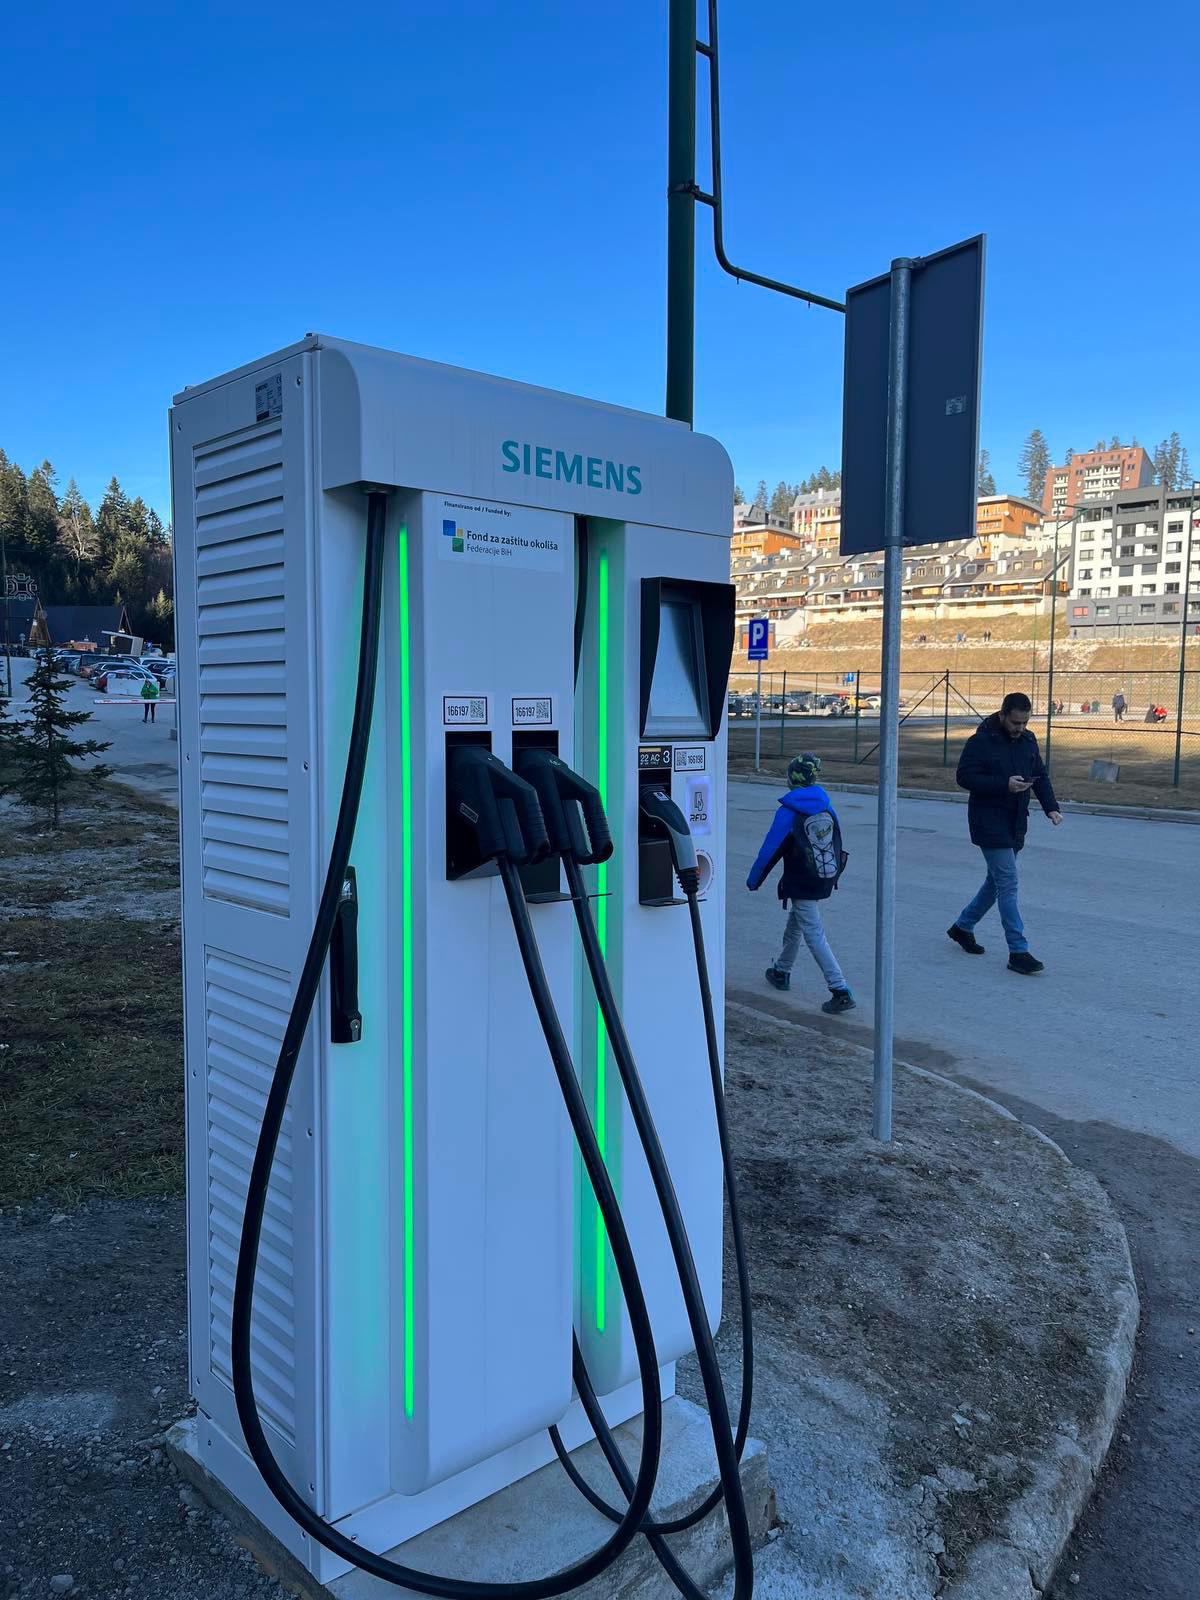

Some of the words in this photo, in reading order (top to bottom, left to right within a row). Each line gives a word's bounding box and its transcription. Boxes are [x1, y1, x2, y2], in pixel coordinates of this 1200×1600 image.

[501, 439, 642, 495] SIEMENS
[466, 530, 489, 542] Fond
[490, 535, 500, 543] za
[501, 534, 529, 547] zaštitu
[466, 543, 500, 556] Federacije
[752, 623, 764, 646] P
[447, 705, 469, 717] 166197
[640, 753, 649, 762] 22
[650, 753, 661, 762] AC
[663, 750, 671, 764] 3
